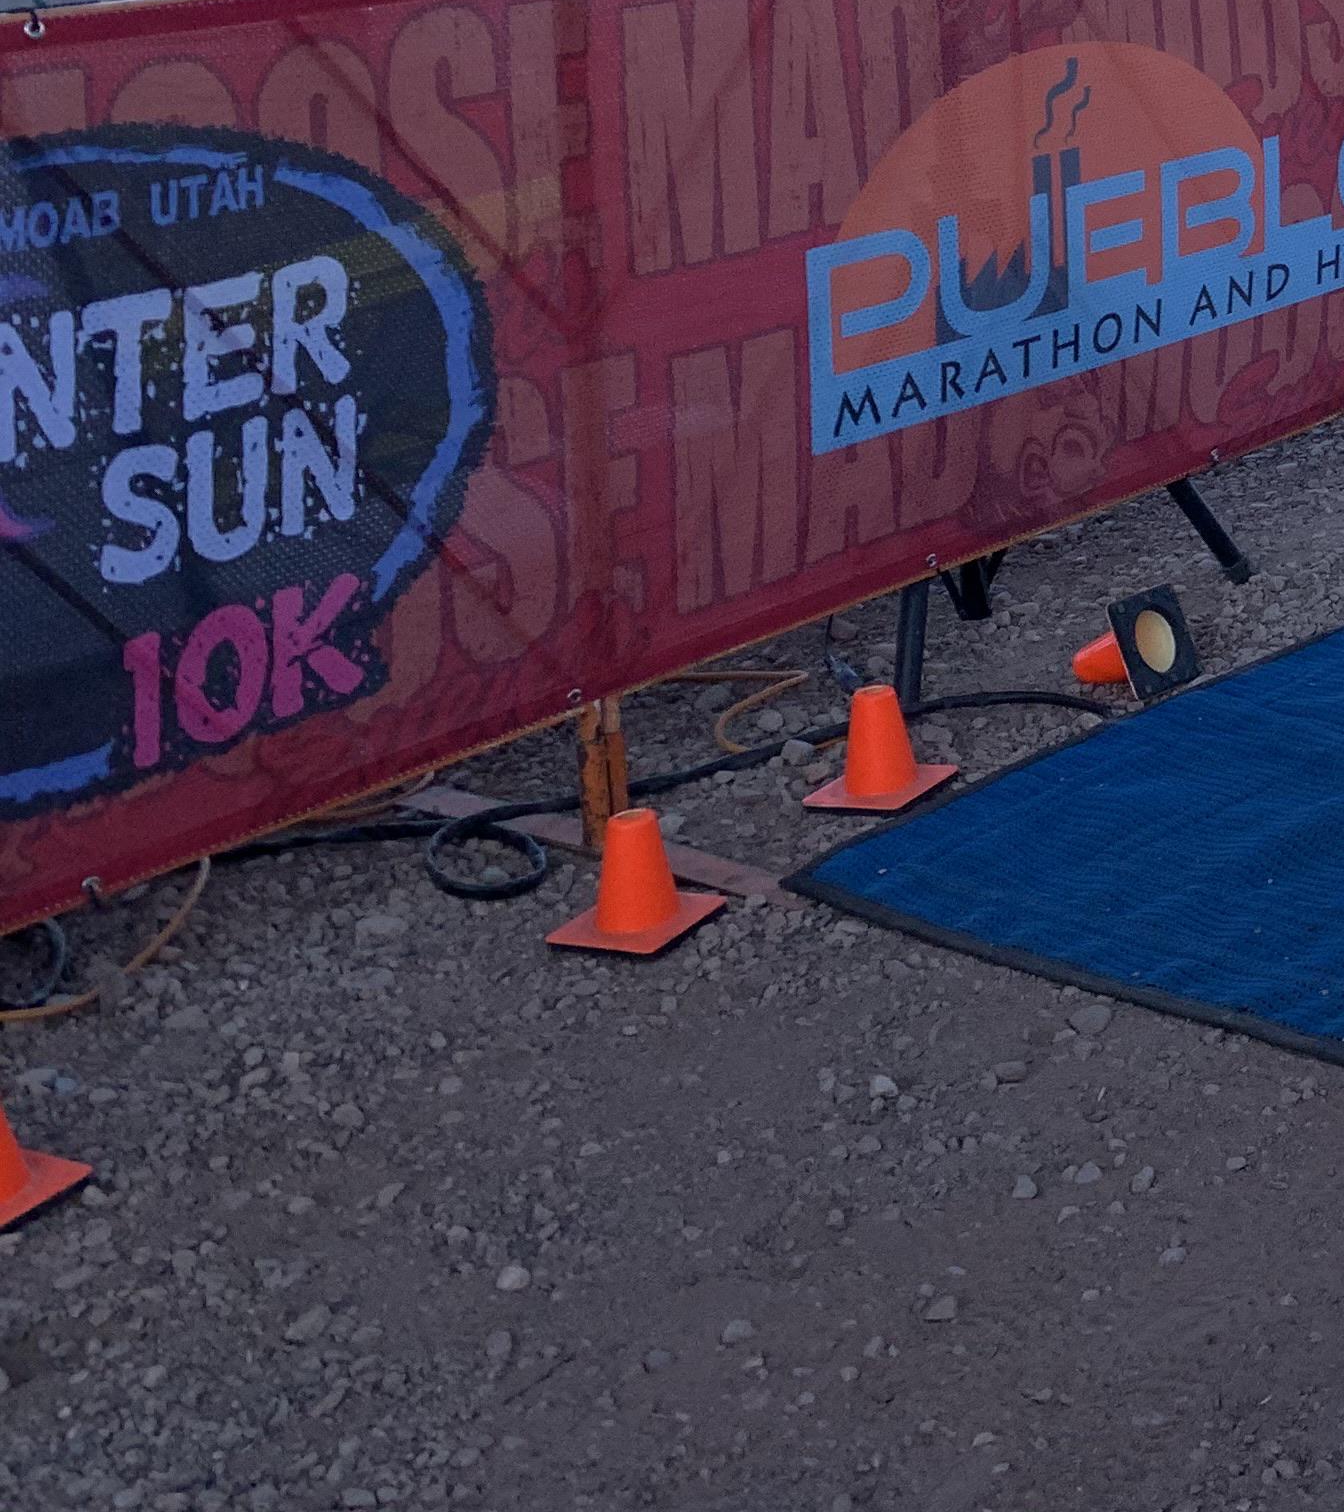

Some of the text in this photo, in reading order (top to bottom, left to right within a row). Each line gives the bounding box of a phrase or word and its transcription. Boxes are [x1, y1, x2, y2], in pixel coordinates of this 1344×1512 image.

[0, 164, 266, 252] MOAB UTAH
[832, 298, 1163, 440] MARATHON
[1189, 262, 1292, 337] AND
[98, 395, 362, 586] SUN
[123, 573, 366, 769] 10K
